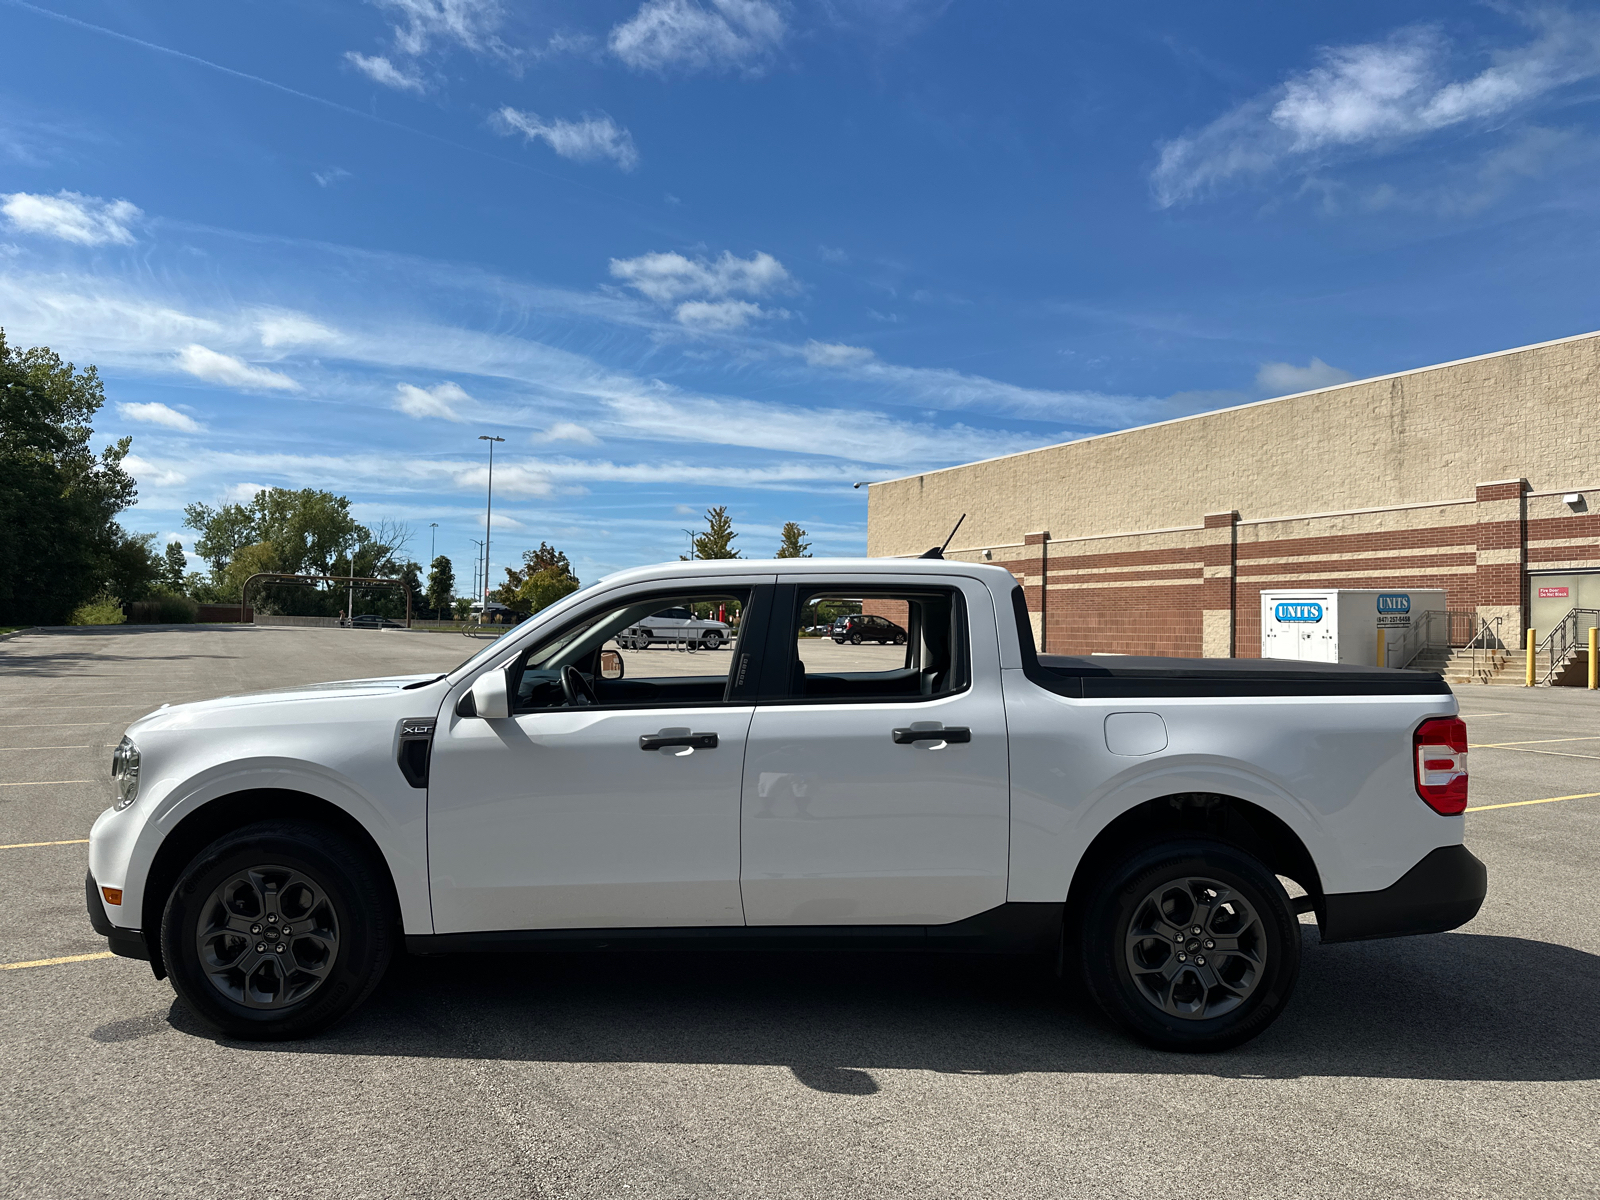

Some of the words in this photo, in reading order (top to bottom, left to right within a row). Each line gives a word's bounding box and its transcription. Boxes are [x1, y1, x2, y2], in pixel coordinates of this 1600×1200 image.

[1379, 597, 1408, 609] UNITS
[1278, 606, 1319, 618] UNITS
[403, 726, 433, 734] XLT
